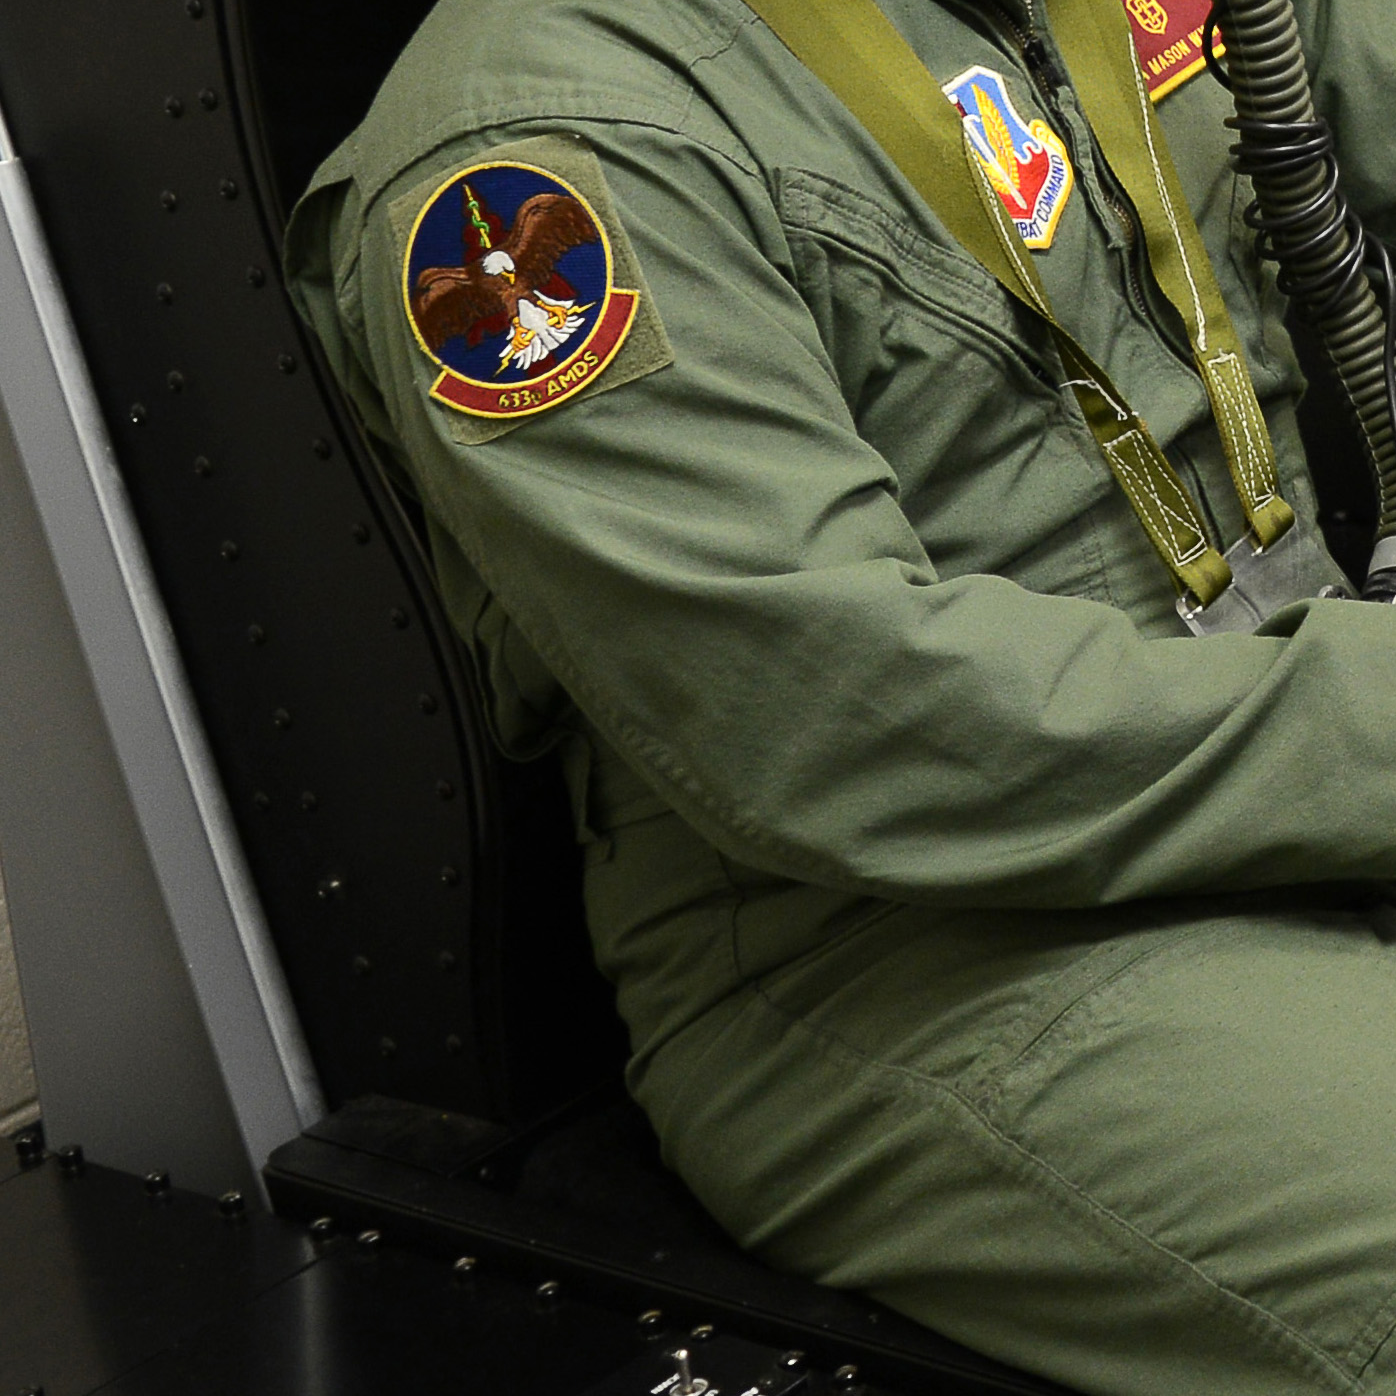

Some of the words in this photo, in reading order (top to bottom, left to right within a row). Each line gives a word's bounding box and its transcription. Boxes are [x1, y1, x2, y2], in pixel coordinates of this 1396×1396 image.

[1146, 38, 1192, 76] MASON
[1036, 153, 1065, 223] COMMAND
[546, 349, 600, 397] AMDS
